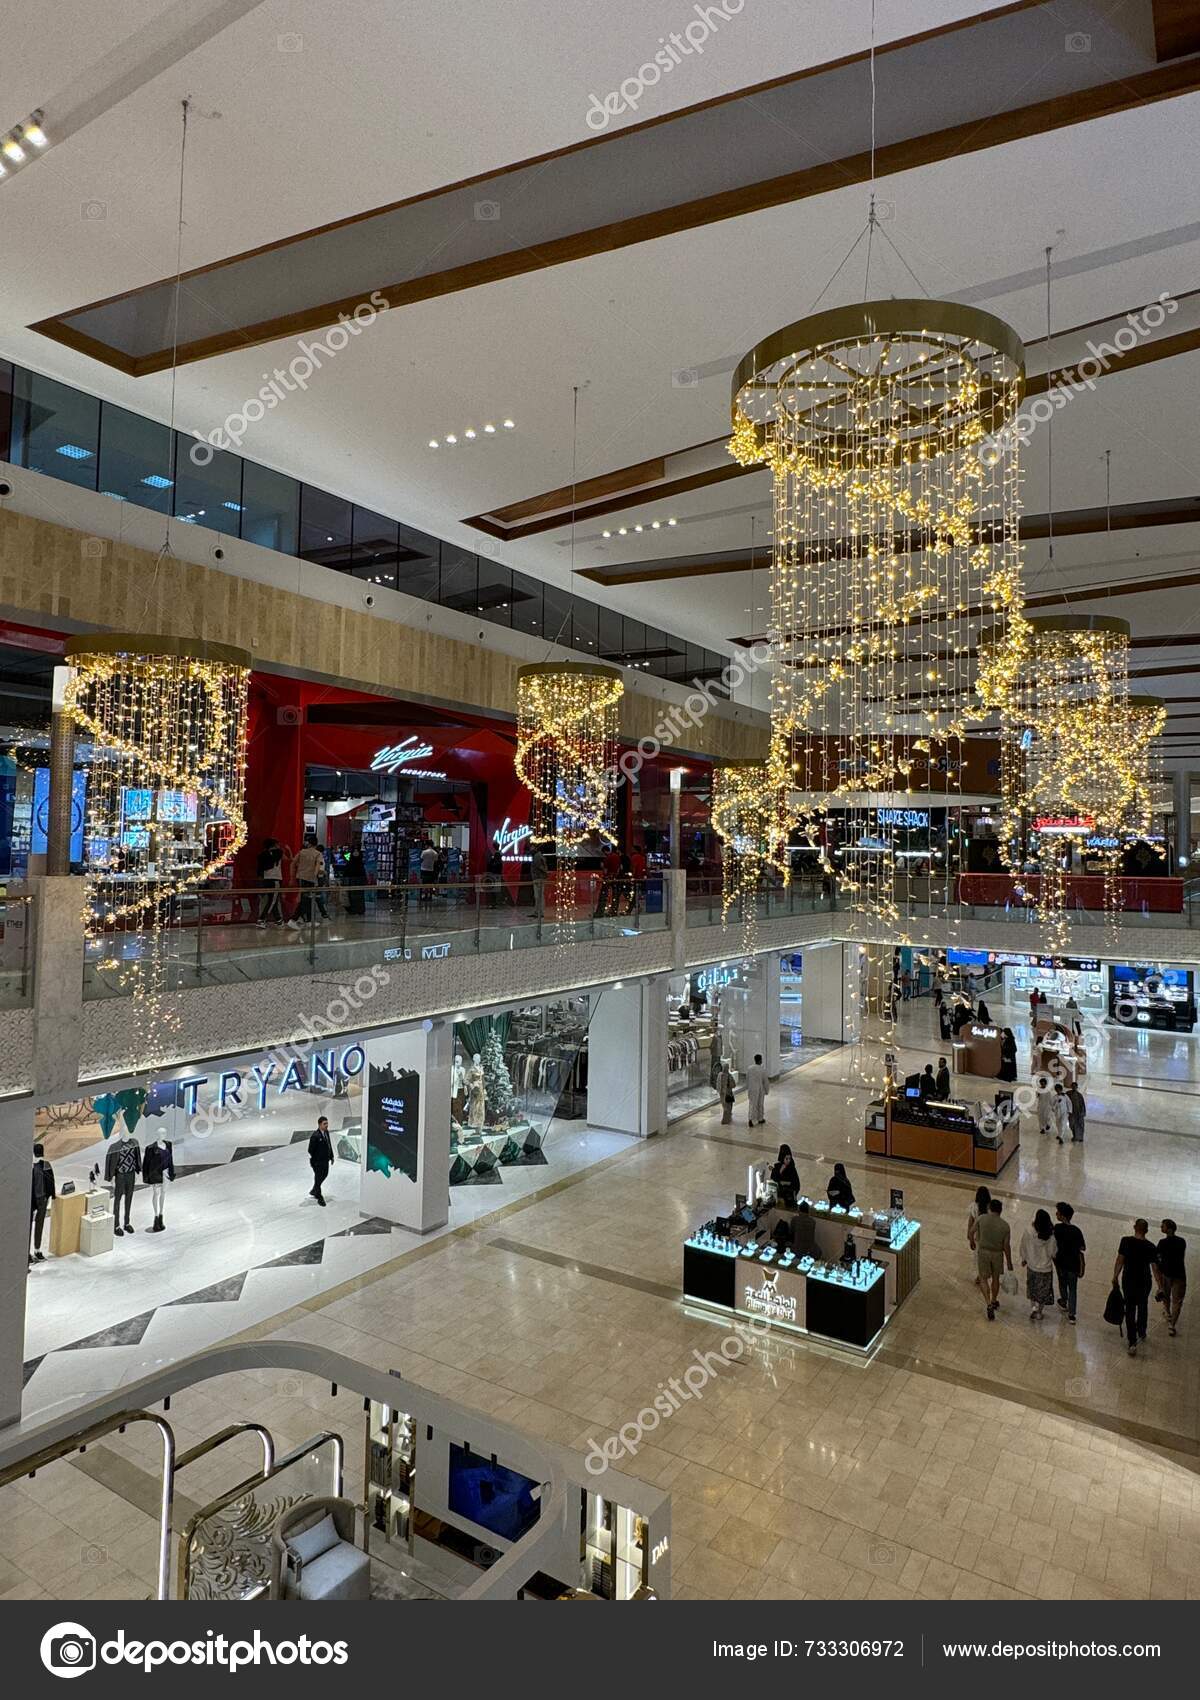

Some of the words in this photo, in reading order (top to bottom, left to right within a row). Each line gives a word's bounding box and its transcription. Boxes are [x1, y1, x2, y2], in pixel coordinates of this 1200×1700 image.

[370, 736, 433, 774] Virgin
[493, 817, 533, 855] Virgin
[877, 808, 903, 825] SHAKE
[903, 810, 928, 827] SHACK
[180, 1044, 366, 1116] TRYANO
